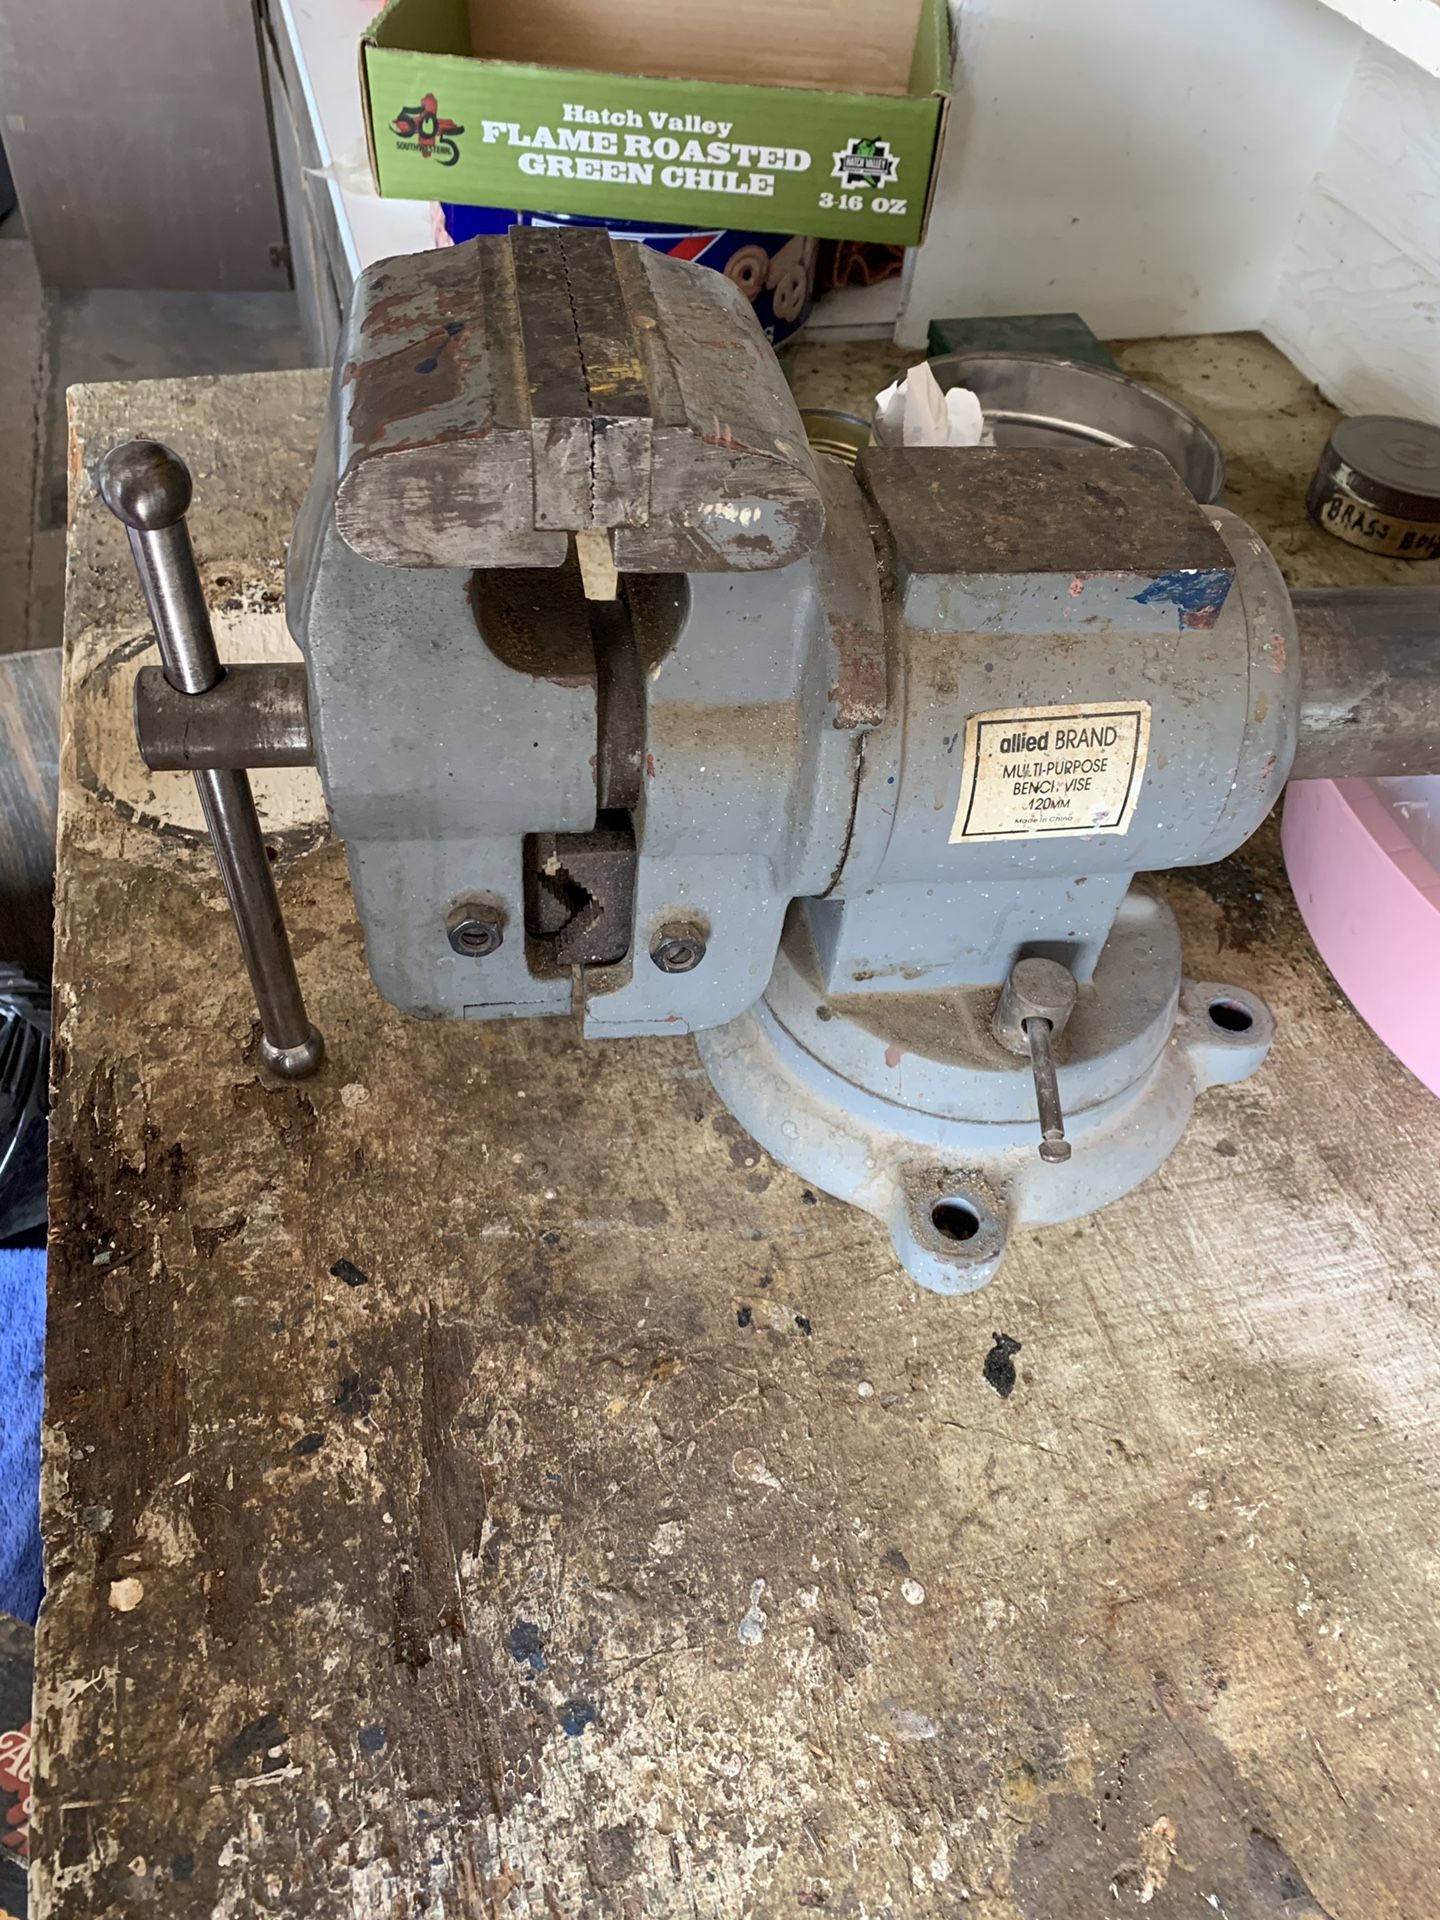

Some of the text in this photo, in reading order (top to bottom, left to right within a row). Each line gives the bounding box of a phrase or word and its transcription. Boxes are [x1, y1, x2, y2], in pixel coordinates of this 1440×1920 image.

[562, 103, 734, 138] Hatch Valley
[388, 105, 465, 167] 505
[396, 141, 452, 156] SOUTHWESTERN
[481, 120, 812, 172] FLAME ROASTED
[518, 152, 775, 197] GREEN CHILE
[871, 197, 908, 215] OZ
[1327, 497, 1391, 539] BRASS
[999, 726, 1118, 754] allied BRAND
[1002, 757, 1108, 779] MULTI-PURPOSE
[1064, 776, 1093, 793] VISE
[1027, 797, 1071, 811] 120MM
